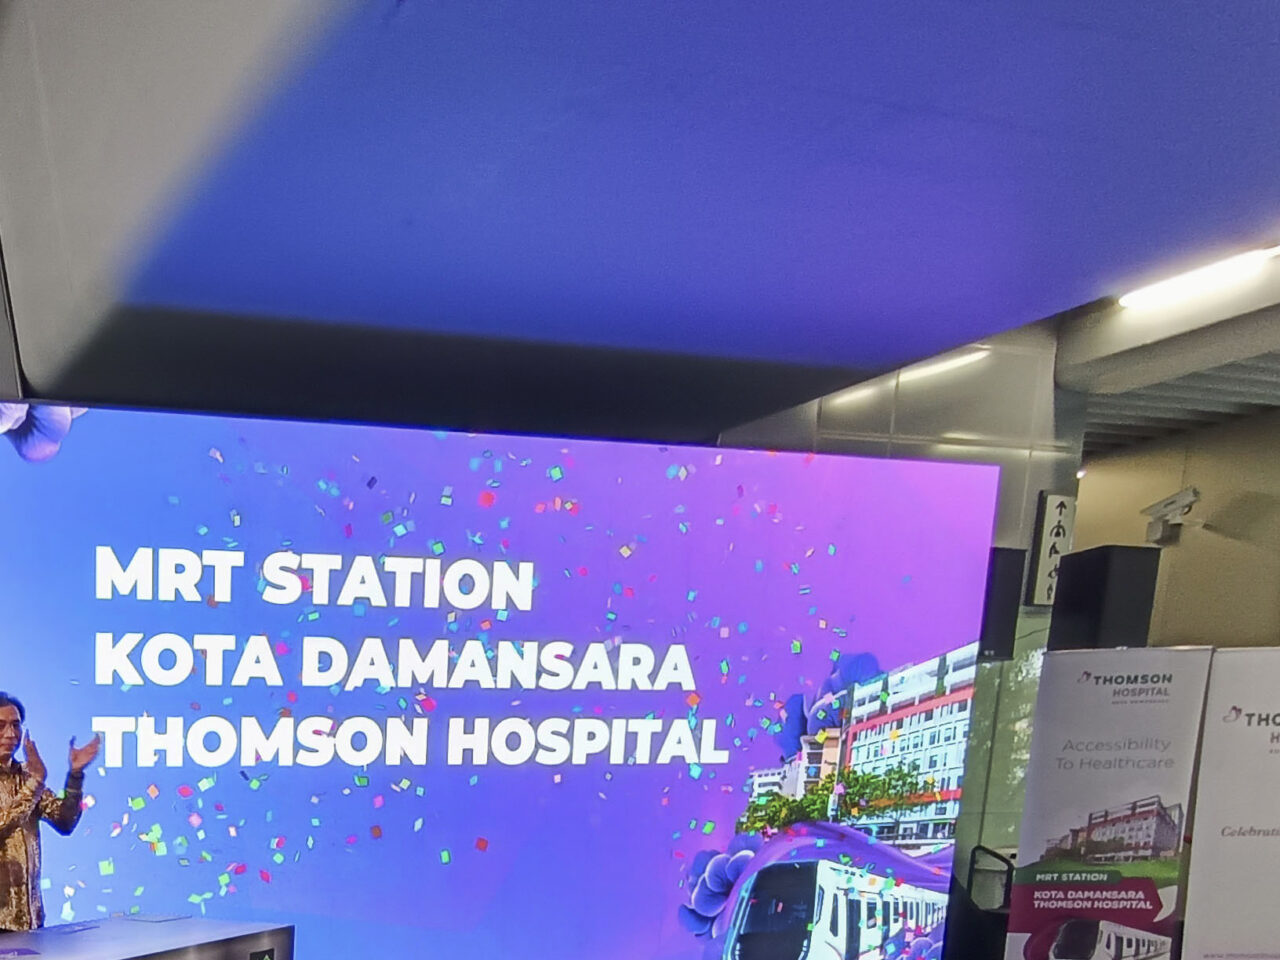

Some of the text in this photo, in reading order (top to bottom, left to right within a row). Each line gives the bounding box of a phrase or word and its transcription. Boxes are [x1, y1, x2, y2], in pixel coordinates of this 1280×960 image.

[95, 546, 534, 611] MRT STATION
[94, 632, 697, 691] KOTA DAMANSARA
[1093, 673, 1173, 686] THOMSON
[1112, 686, 1170, 698] HOSPITAL
[91, 715, 730, 768] THOMSON HOSPITAL
[1061, 737, 1173, 753] Accessibility
[1056, 756, 1176, 771] To Healthcare
[1035, 872, 1109, 882] MRT STATION
[1033, 890, 1145, 900] KOTA DAMANSARA
[1033, 900, 1153, 910] THOMSON HOSPITAL
